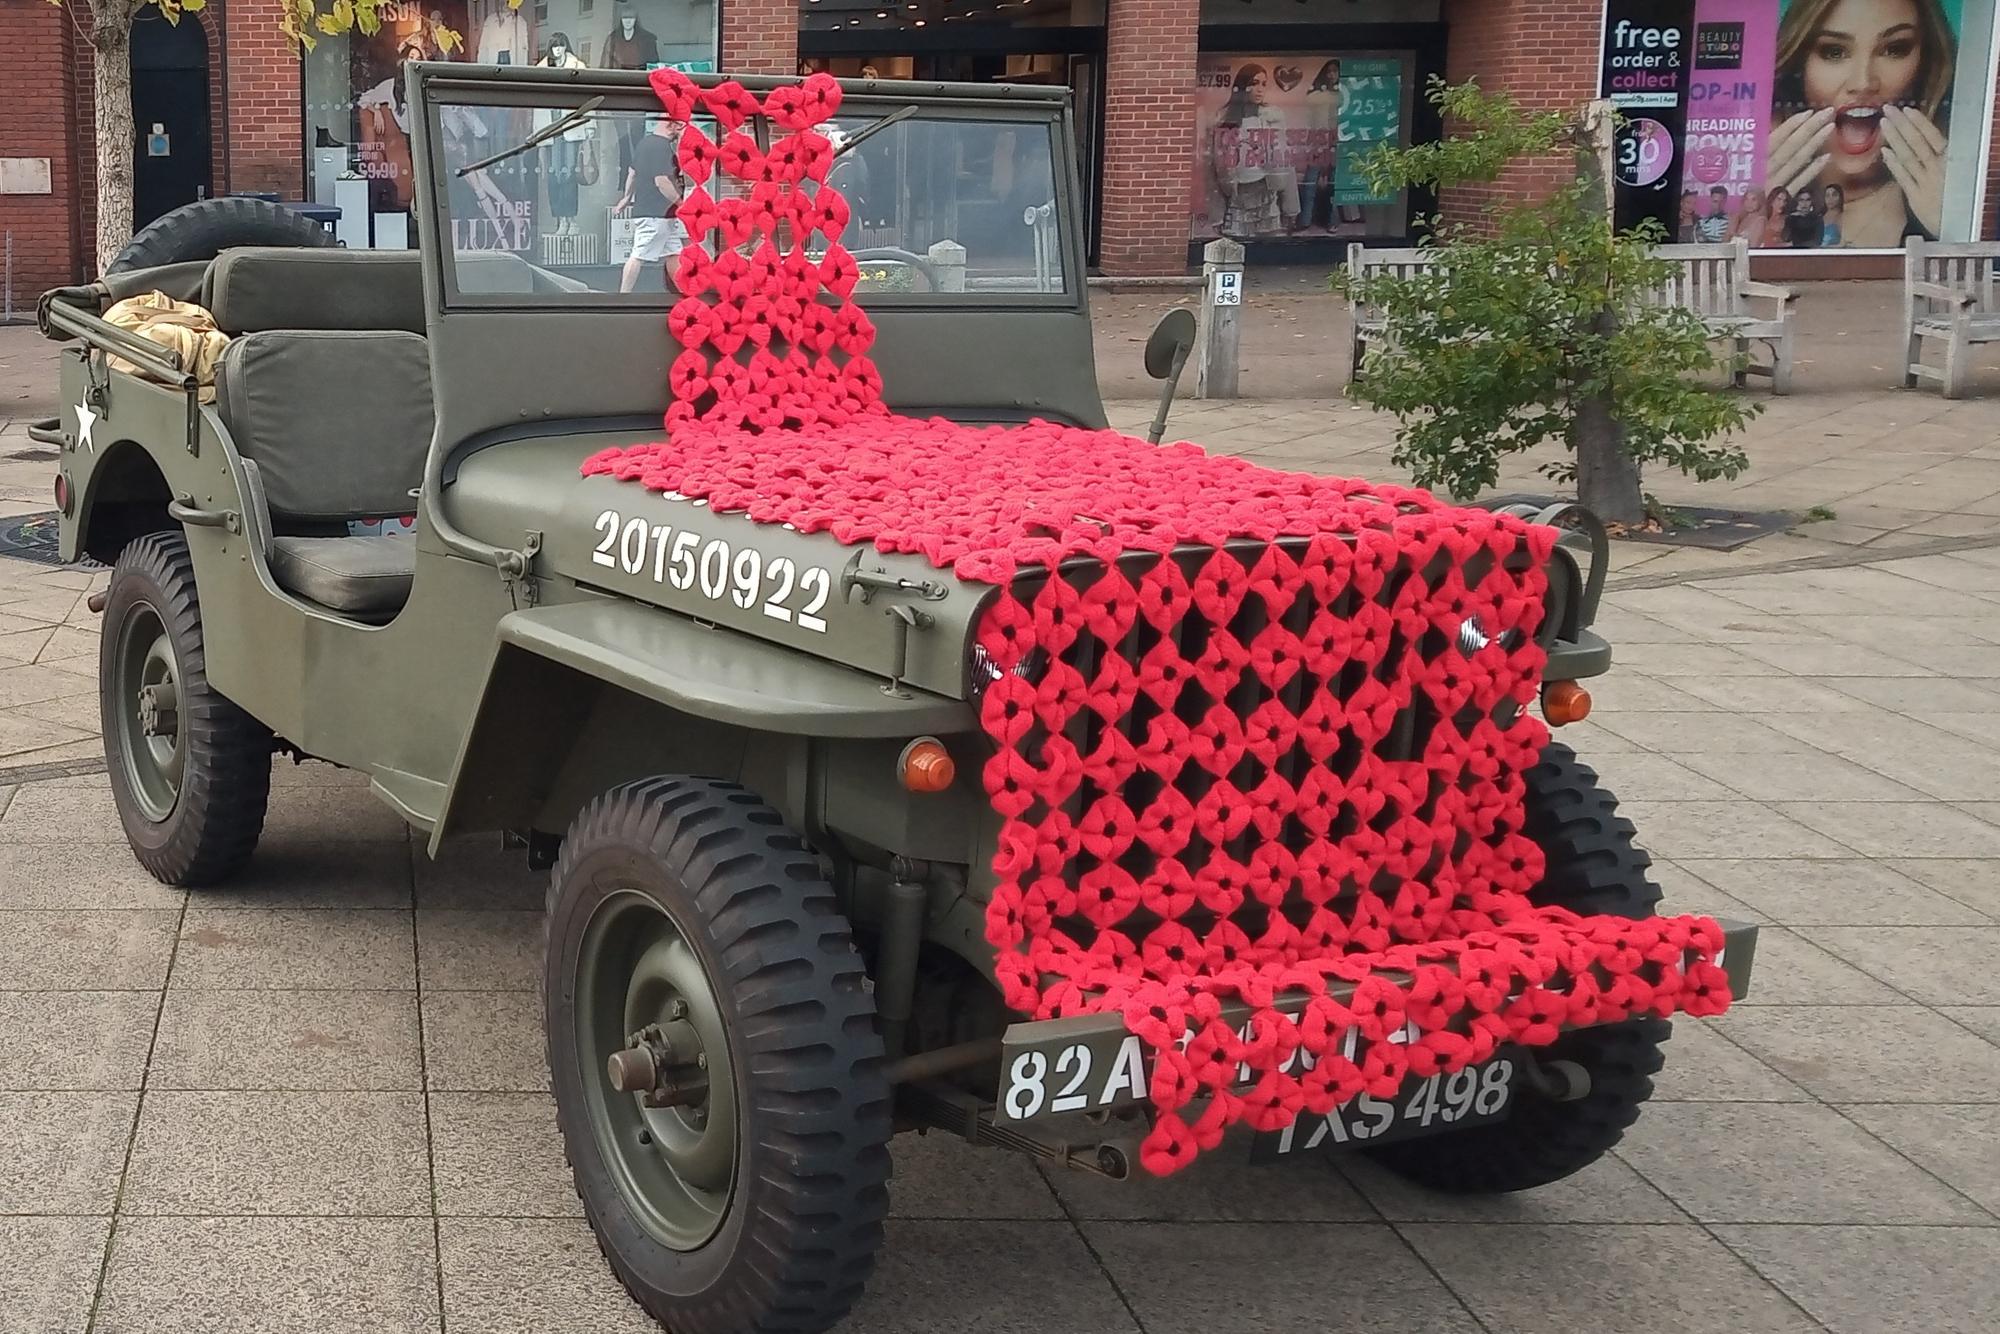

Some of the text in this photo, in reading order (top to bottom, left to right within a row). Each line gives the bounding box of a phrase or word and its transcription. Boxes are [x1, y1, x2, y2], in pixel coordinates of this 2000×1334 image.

[1615, 20, 1681, 48] free
[1699, 31, 1741, 42] BEAUTY
[1612, 51, 1681, 67] order &
[1699, 43, 1740, 52] STUDO
[1612, 70, 1678, 87] collect
[1619, 138, 1660, 164] 30
[514, 201, 532, 216] BE
[451, 218, 532, 251] LUXE
[592, 509, 831, 633] 20150922
[1005, 1029, 1196, 1120] 82A
[1403, 1059, 1513, 1127] 498
